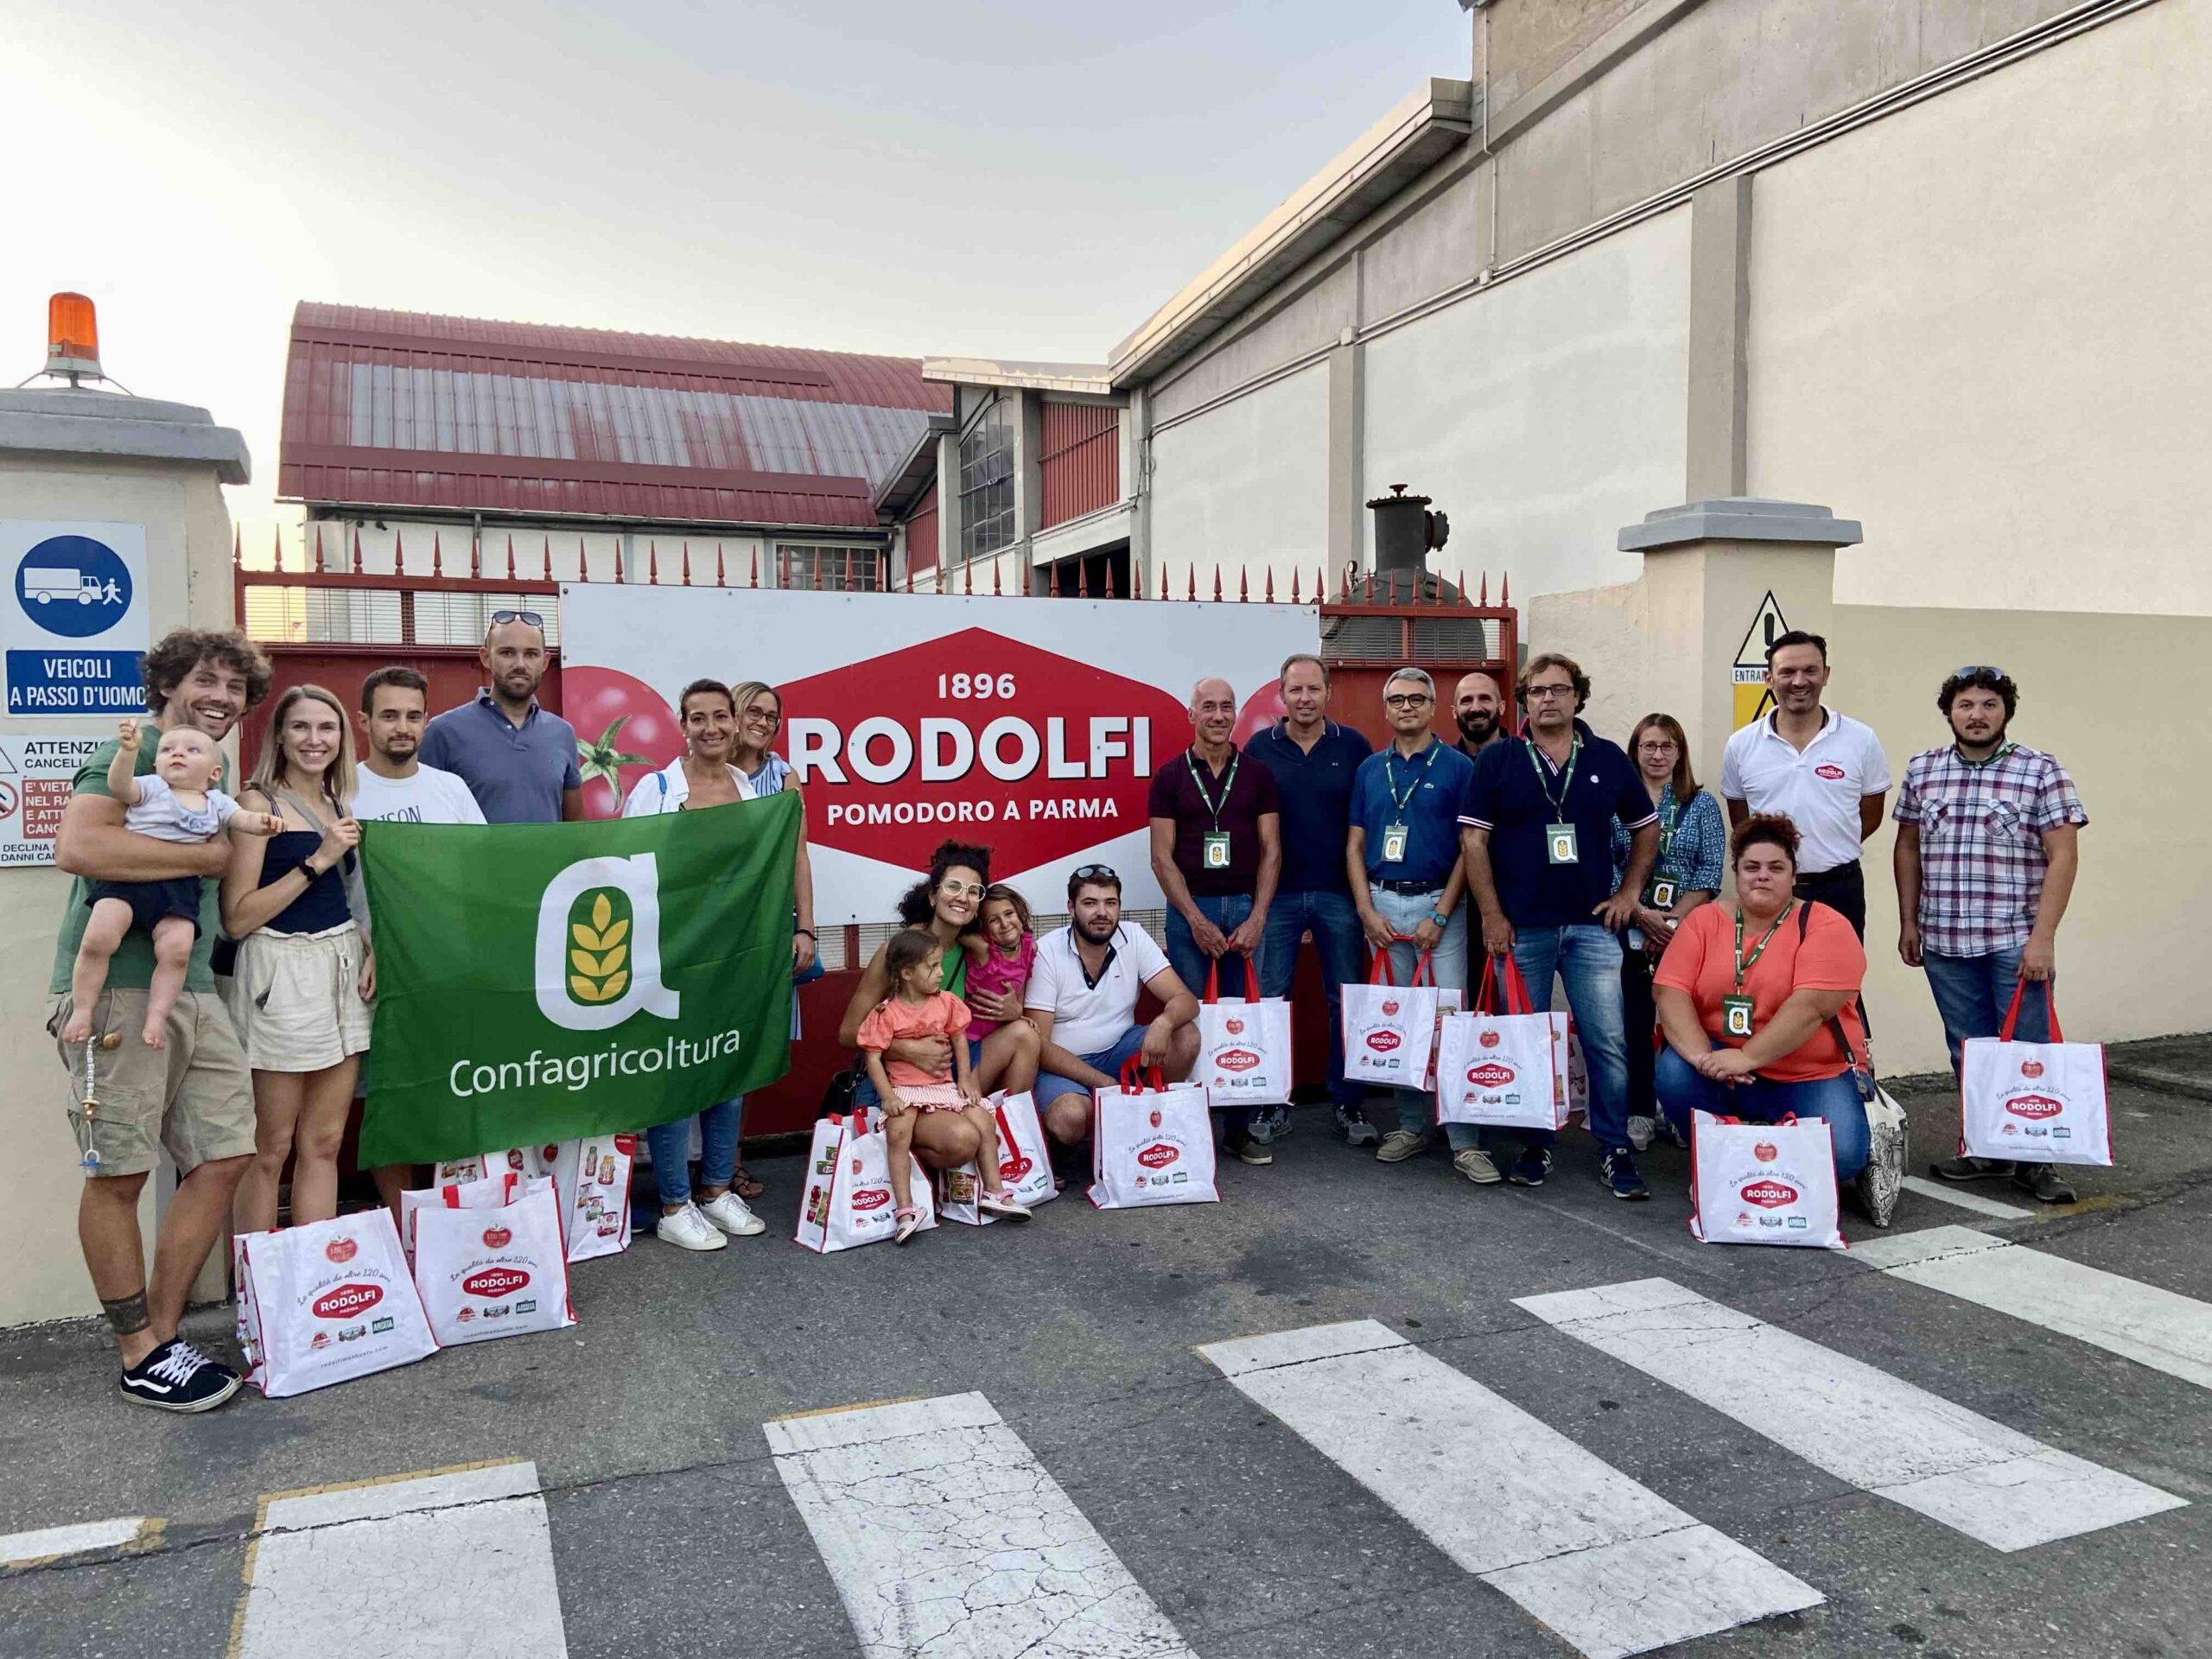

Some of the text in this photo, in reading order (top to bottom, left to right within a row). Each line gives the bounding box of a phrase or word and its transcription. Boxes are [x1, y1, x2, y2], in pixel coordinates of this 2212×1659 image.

[43, 658, 111, 679] VEICOLI
[938, 673, 1017, 699] 1896
[10, 686, 22, 706] A
[27, 686, 79, 707] PASSO
[25, 741, 105, 754] ATTENZI
[787, 715, 1151, 784] RODOLFI
[25, 782, 36, 793] E'
[25, 796, 50, 807] NEL
[26, 810, 35, 820] E
[827, 798, 1119, 827] POMODORO A PARMA
[3, 843, 49, 853] DECLINA
[1, 852, 34, 862] DANNI
[449, 1029, 741, 1096] Confagricoltura
[2012, 1103, 2056, 1111] RODOLFI
[1143, 1150, 1174, 1161] RODOLFI
[852, 1192, 886, 1206] RODOLFI
[1747, 1190, 1791, 1198] RODOLFI
[513, 1255, 529, 1264] 120
[362, 1268, 379, 1277] 120
[470, 1274, 523, 1289] RODOLFI
[321, 1289, 376, 1312] RODOLFI
